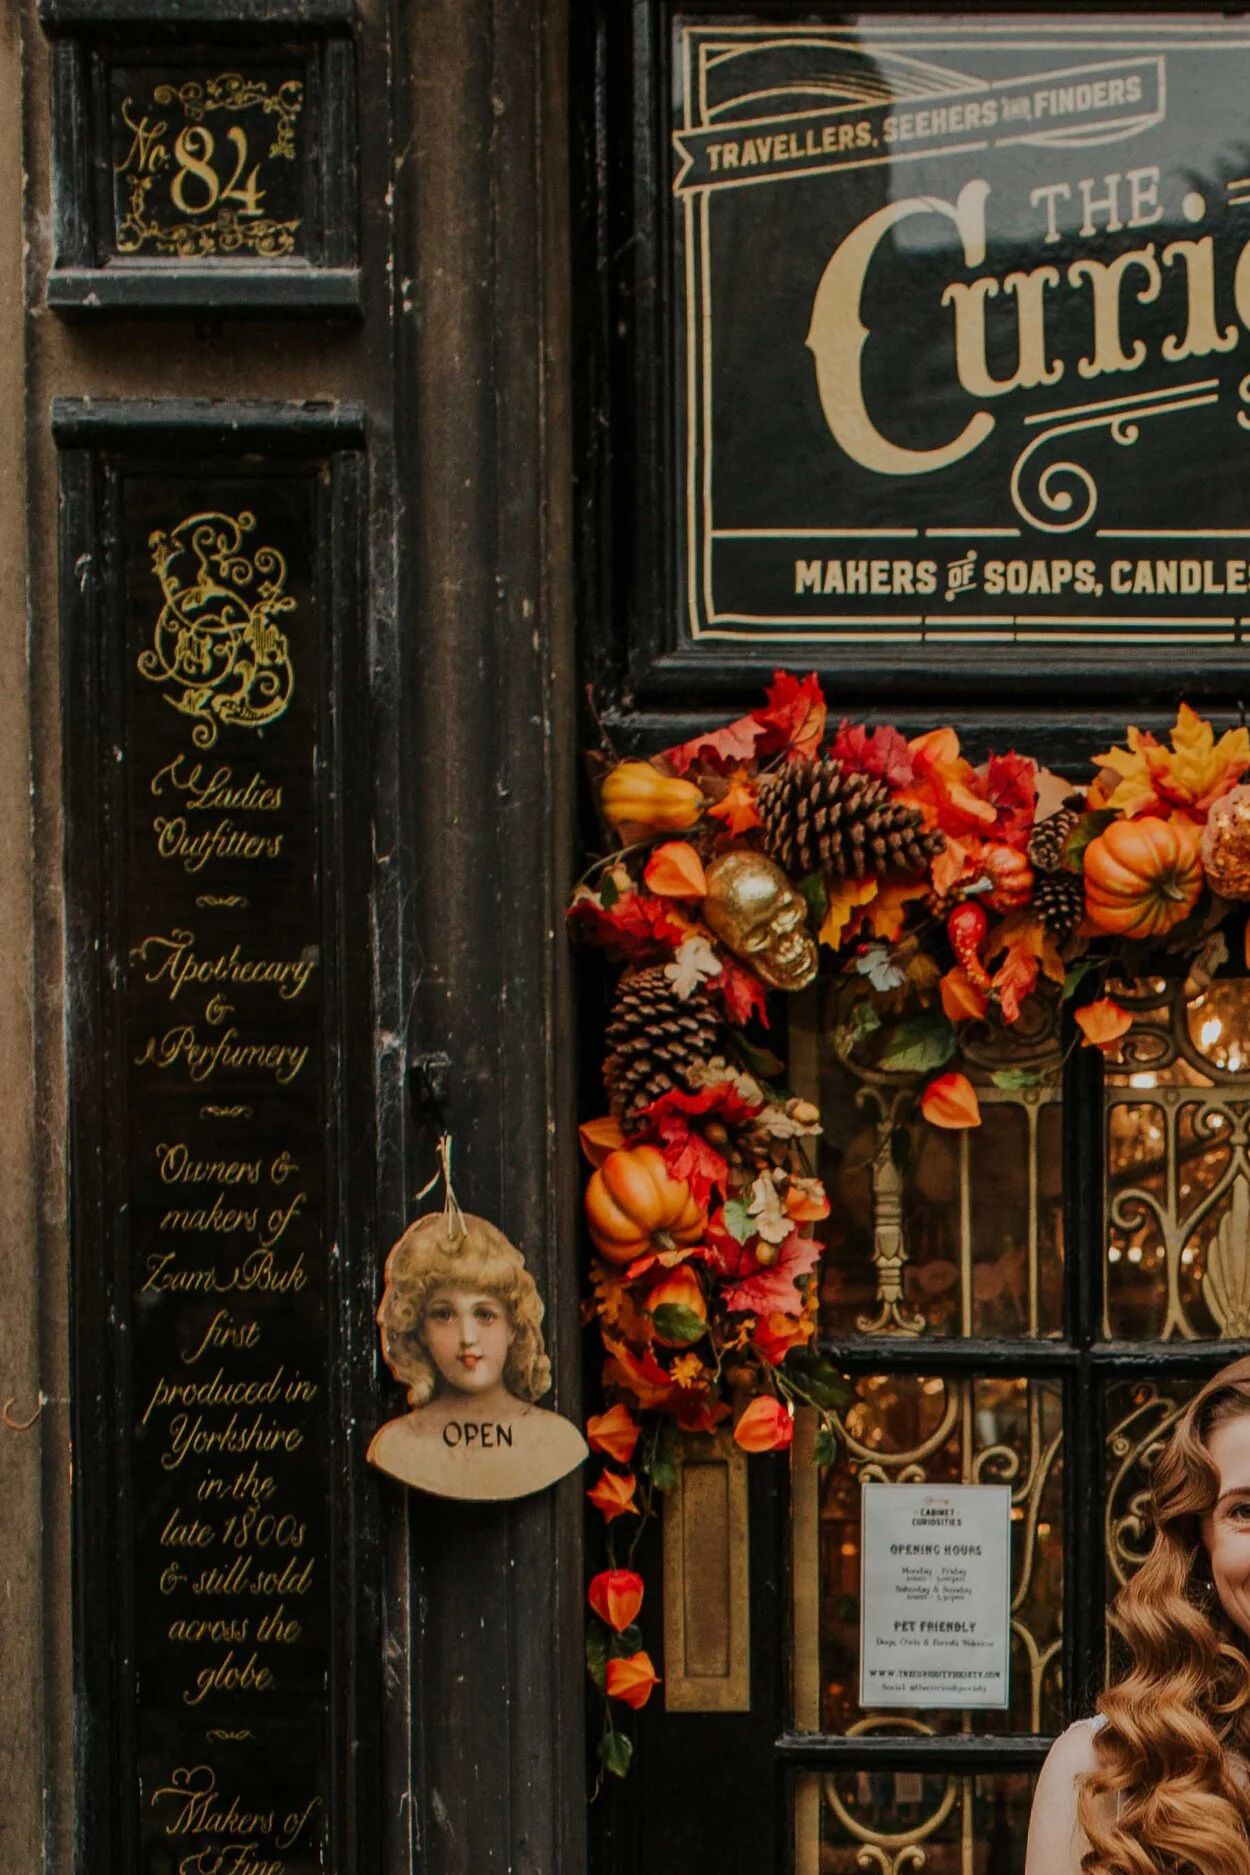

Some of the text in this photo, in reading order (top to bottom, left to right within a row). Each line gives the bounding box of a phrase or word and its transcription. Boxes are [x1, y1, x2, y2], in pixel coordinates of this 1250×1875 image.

[707, 122, 879, 171] TRAVELLERS,
[883, 101, 998, 143] SEEKERS
[1033, 75, 1142, 118] FINDERS
[170, 126, 266, 216] 84
[1030, 166, 1164, 243] THE
[795, 559, 938, 595] MAKERS
[984, 559, 1103, 597] SOAPS,
[151, 753, 283, 810] Ladies
[154, 817, 283, 872] Outfitters
[129, 928, 316, 1000] Apothecary
[205, 993, 234, 1026] &
[134, 1025, 308, 1084] Perfumery
[156, 1143, 299, 1185] Owners &
[159, 1192, 307, 1248] makers of
[180, 1309, 262, 1365] first
[142, 1365, 318, 1424] produced in
[161, 1412, 305, 1470] Yorkshire
[443, 1421, 513, 1448] OPEN
[198, 1460, 279, 1502] in the
[159, 1500, 307, 1548] late 1800s
[890, 1544, 982, 1556] OPENING HOURS
[912, 1518, 962, 1527] CURIOSITIES
[159, 1555, 315, 1595] & still sold
[168, 1604, 303, 1643] across the
[894, 1621, 977, 1633] PET FRIENDLY
[183, 1650, 274, 1706] globe
[152, 1765, 323, 1849] Makers of
